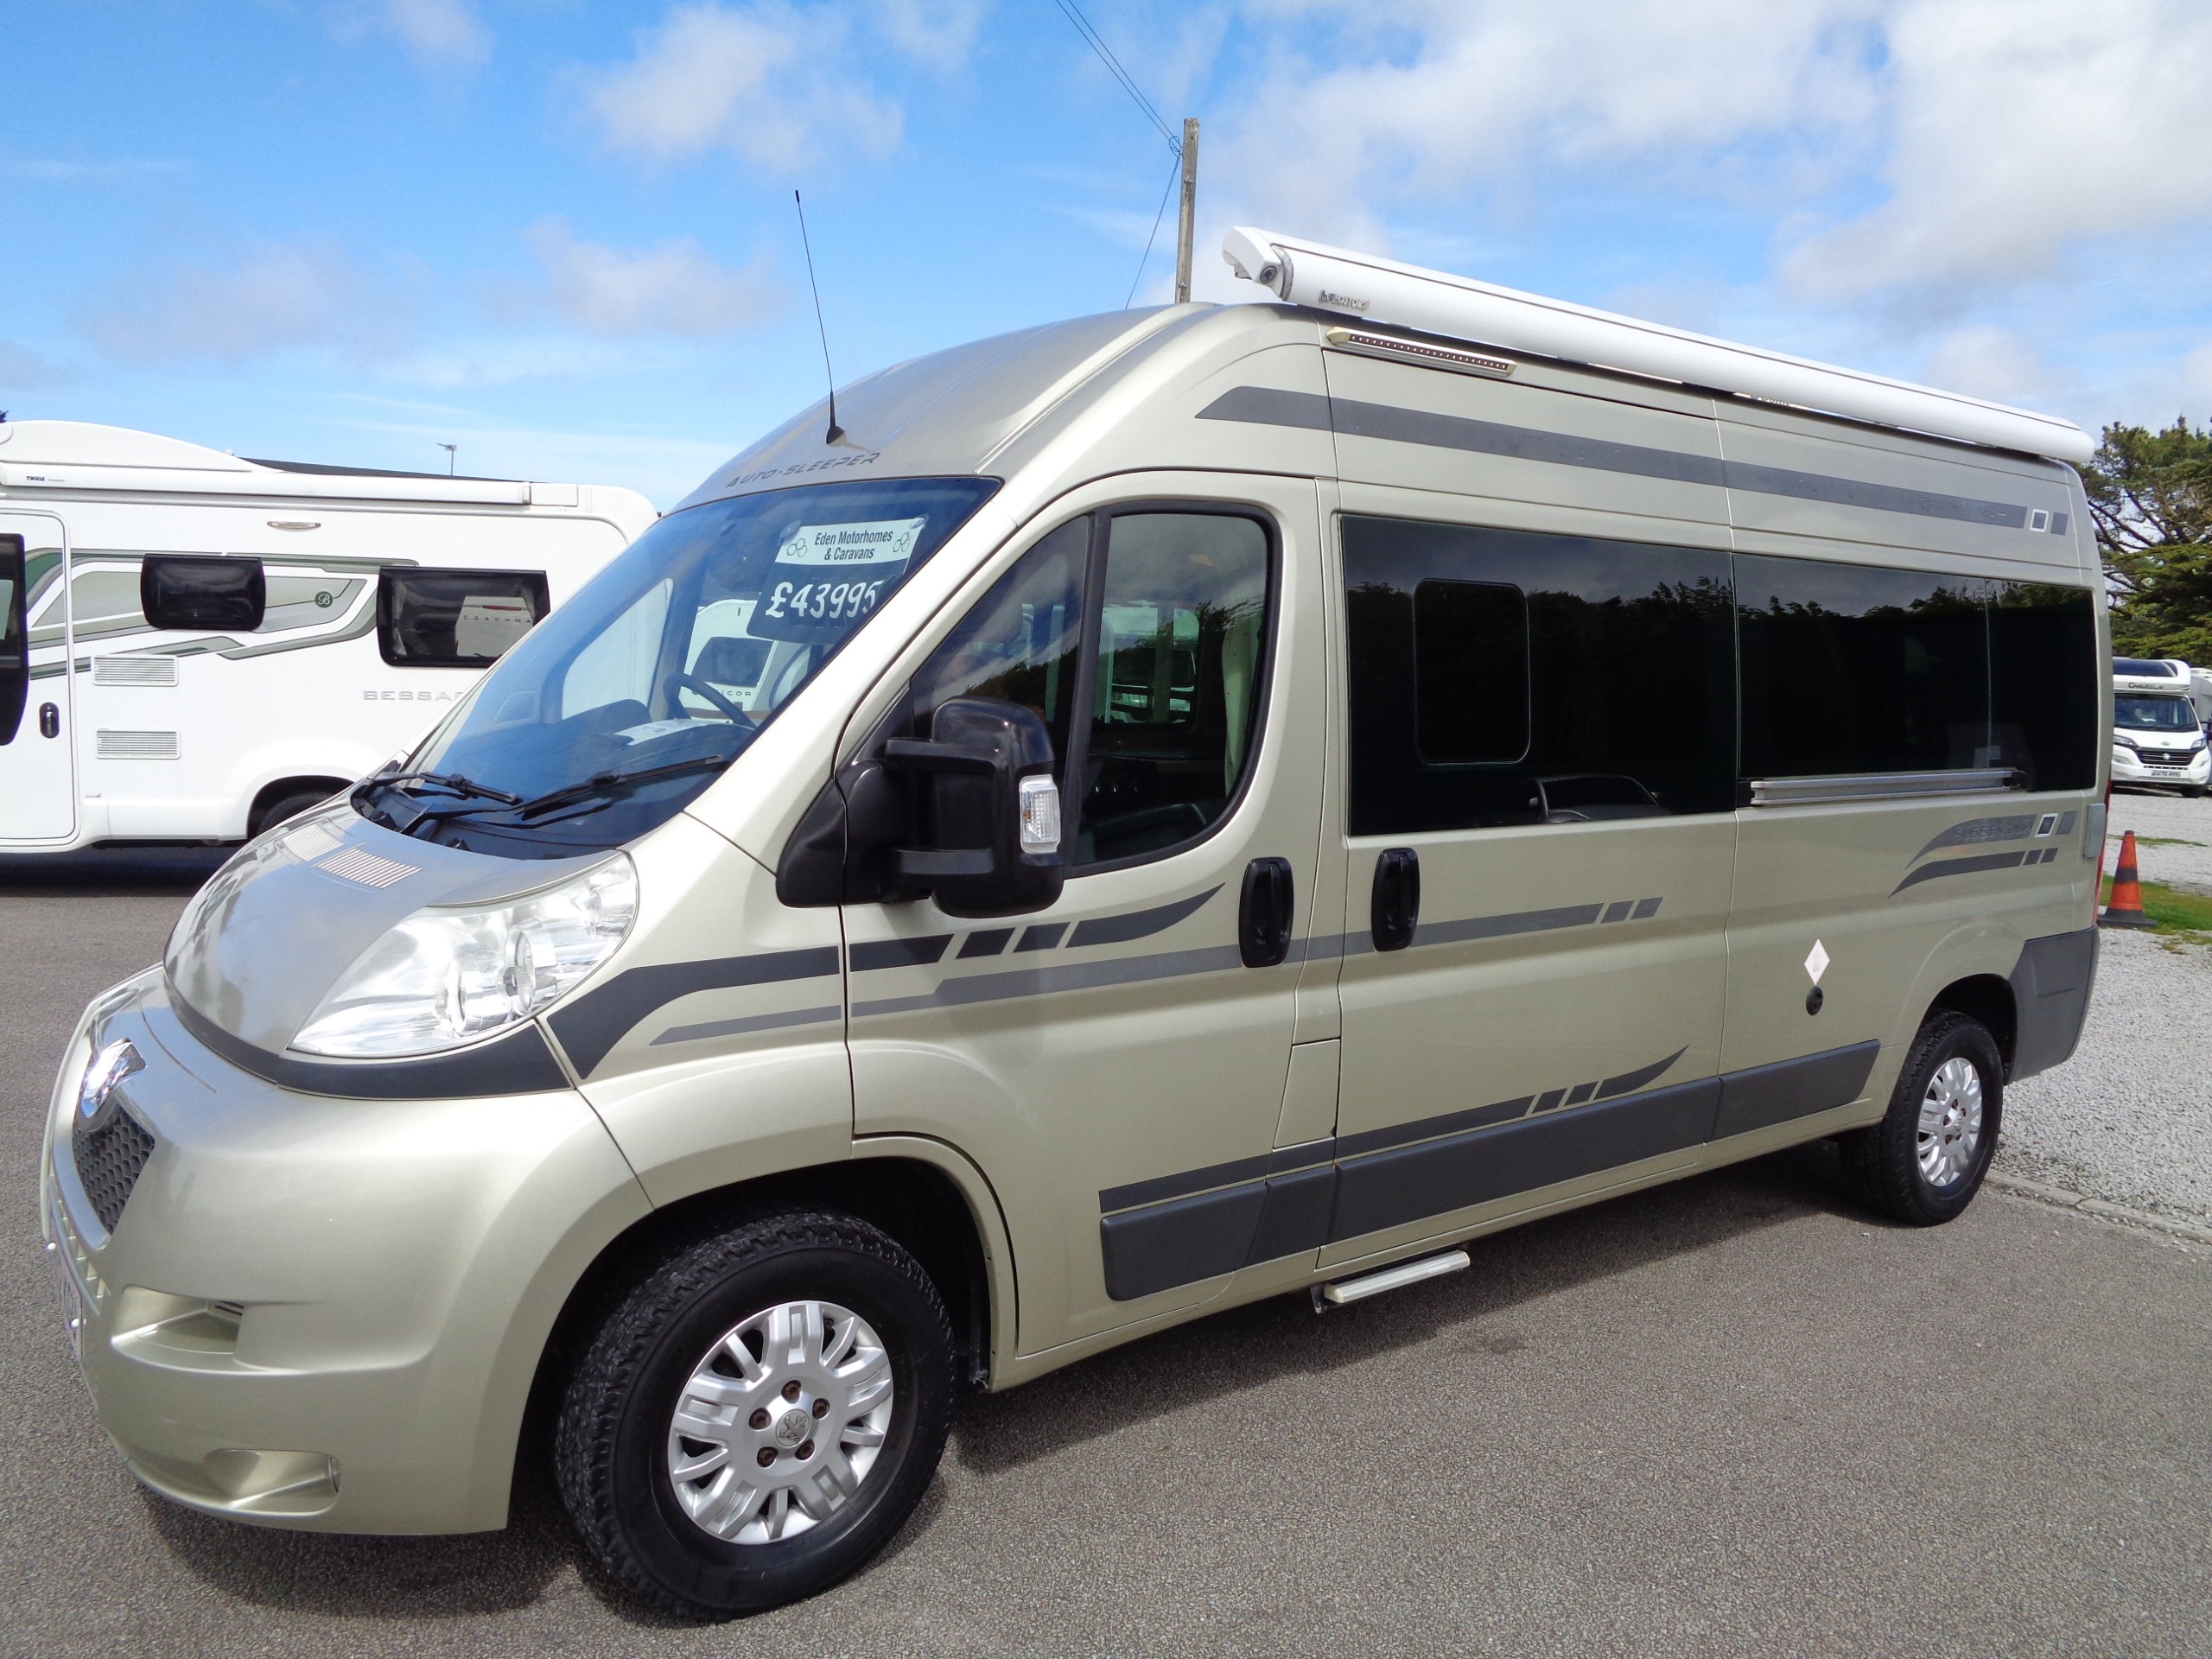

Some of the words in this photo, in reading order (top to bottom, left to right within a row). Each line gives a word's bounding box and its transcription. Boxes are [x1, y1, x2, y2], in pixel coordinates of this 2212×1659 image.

[725, 452, 880, 488] AUTO-SLEEPER
[814, 531, 836, 545] Eden
[837, 530, 893, 545] Motorhomes
[823, 549, 831, 560] &
[834, 547, 875, 560] Caravans
[765, 580, 885, 619] £43995
